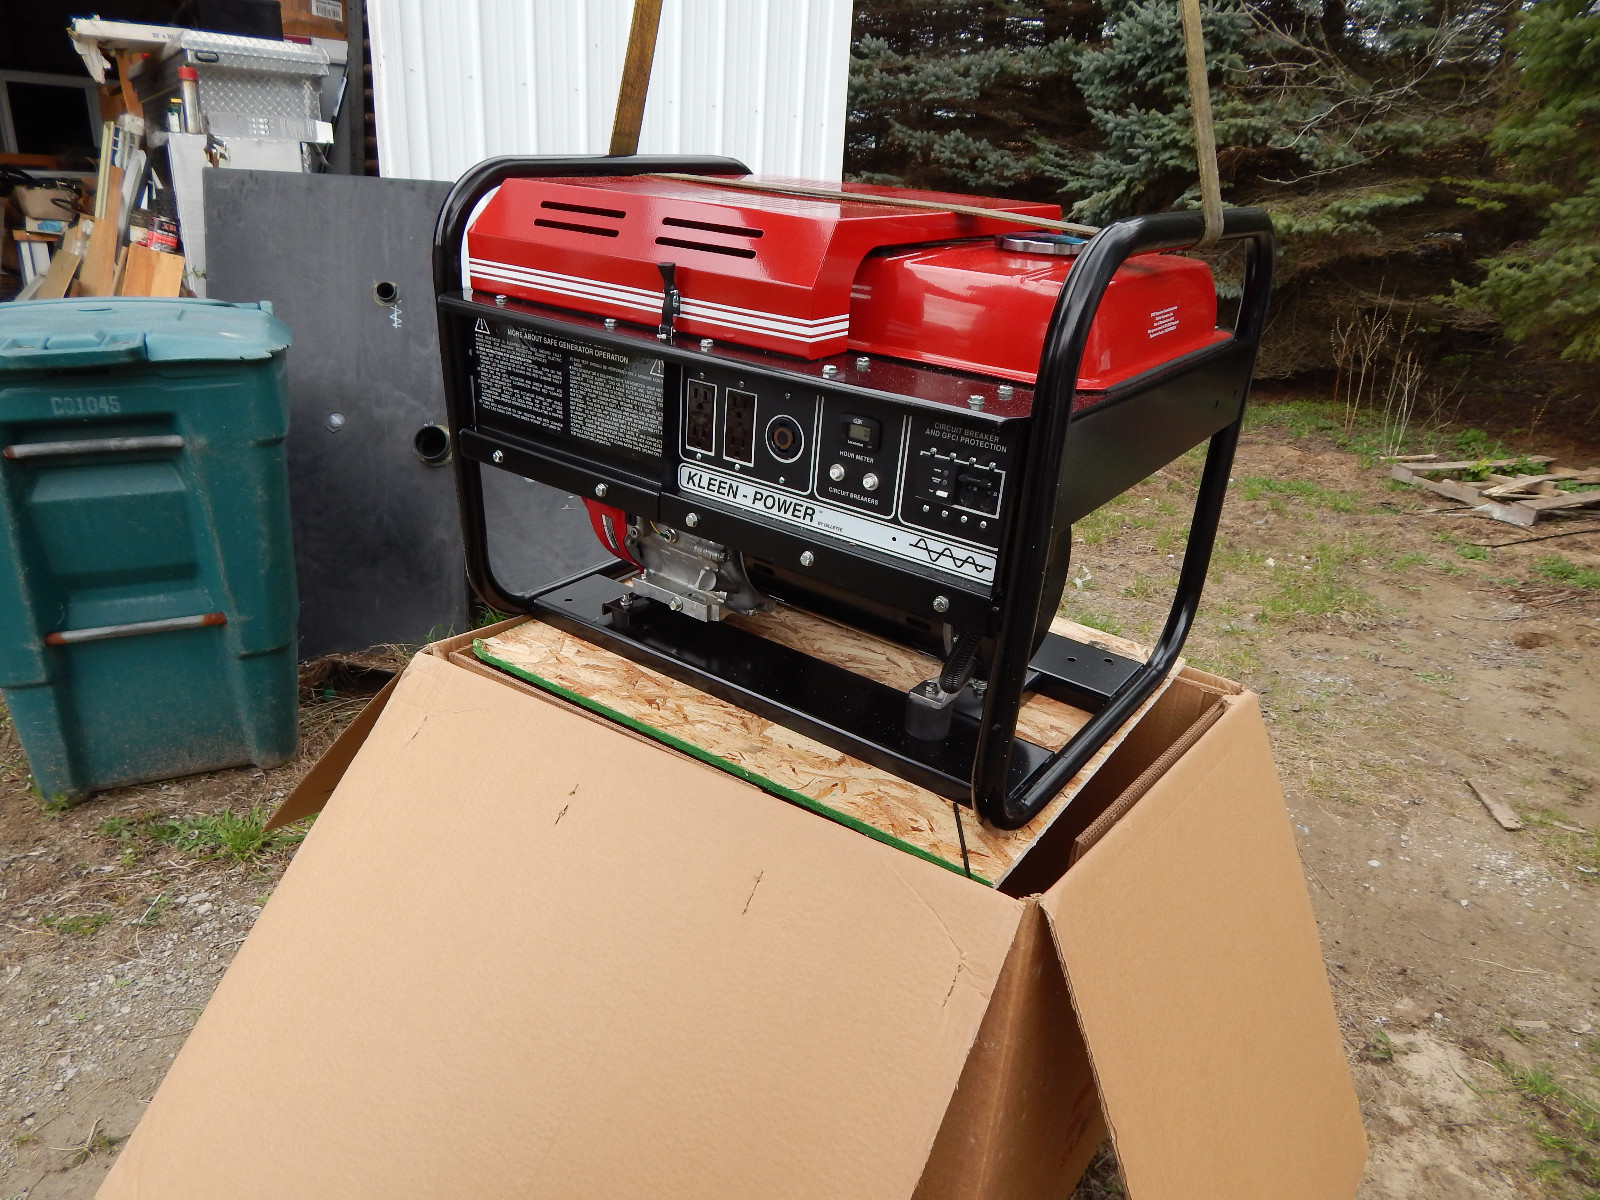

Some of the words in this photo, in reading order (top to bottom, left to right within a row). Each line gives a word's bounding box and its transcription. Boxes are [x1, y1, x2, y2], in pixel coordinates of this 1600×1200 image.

[507, 328, 523, 339] MORE
[523, 332, 543, 343] ABOUT
[543, 337, 558, 347] SAFE
[558, 340, 594, 355] GENERATOR
[594, 349, 629, 364] OPERATION
[925, 428, 940, 438] AND
[941, 431, 958, 441] GFCI
[959, 435, 1008, 453] PROTECTION
[934, 422, 963, 433] CIRCUIT
[964, 427, 1000, 443] BREAKER
[839, 450, 855, 459] HOUR
[855, 453, 874, 464] METER
[686, 470, 739, 500] KLEEN
[751, 490, 816, 523] POWER
[828, 486, 849, 498] CIRCUIT
[849, 491, 879, 506] BREAKERS
